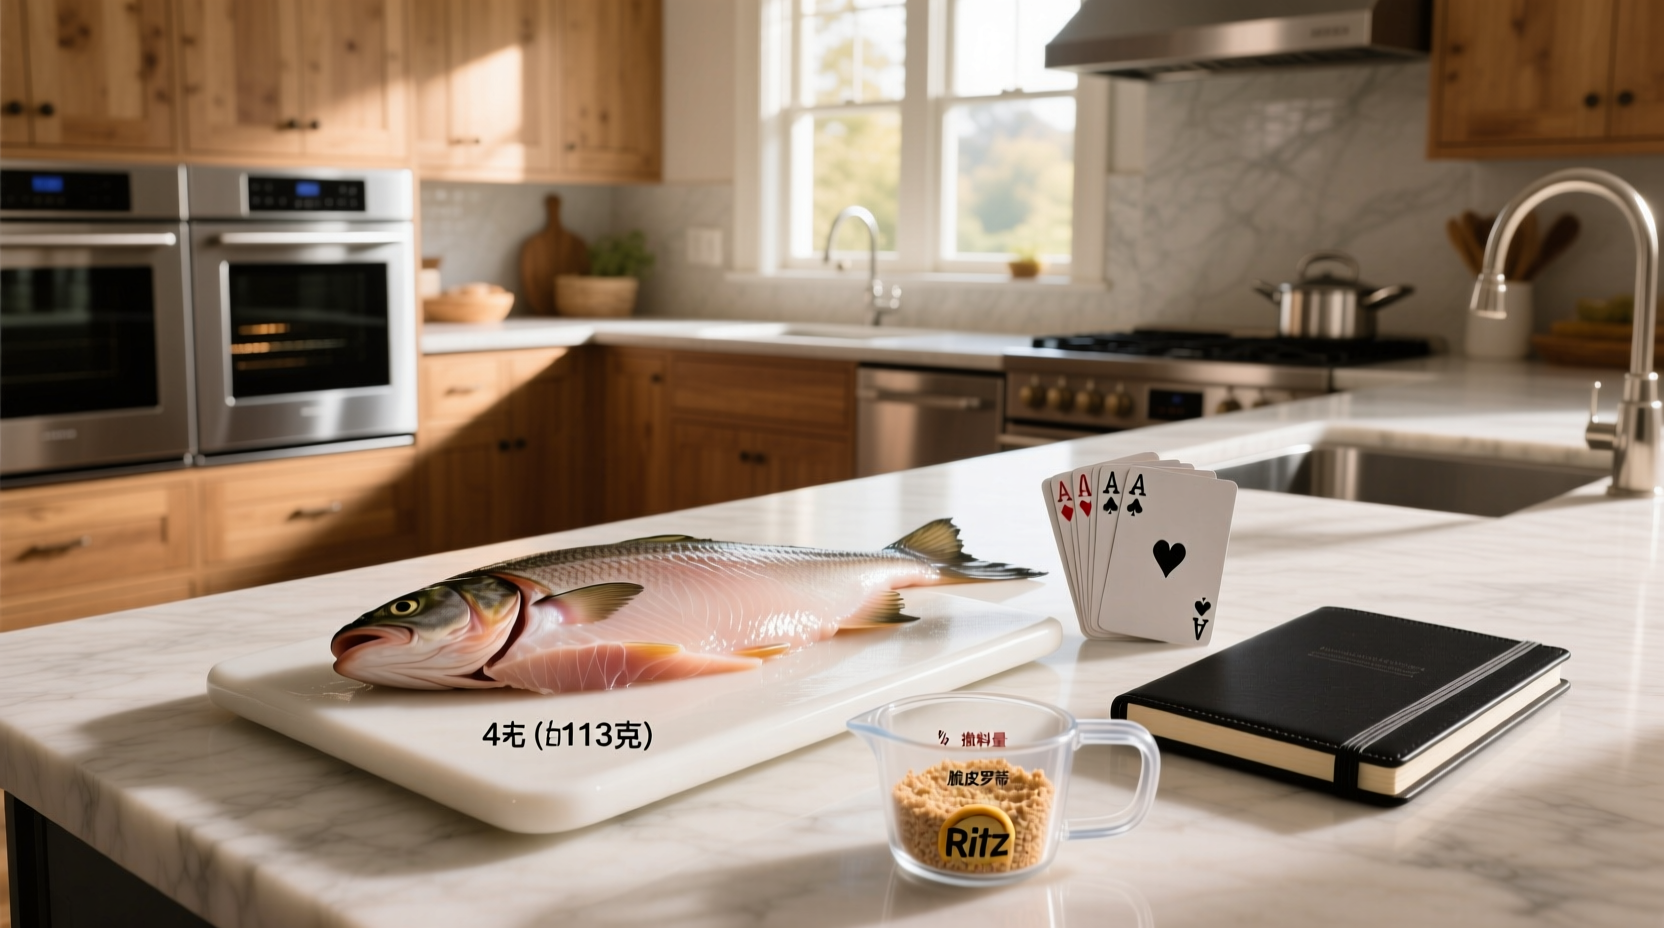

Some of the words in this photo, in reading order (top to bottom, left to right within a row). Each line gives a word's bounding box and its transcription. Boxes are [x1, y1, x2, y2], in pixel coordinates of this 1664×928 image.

[1058, 480, 1073, 503] A
[1078, 473, 1092, 498] A
[1103, 471, 1120, 495] A
[1129, 473, 1147, 497] A
[1192, 617, 1209, 640] A
[945, 826, 1010, 859] Ritz
